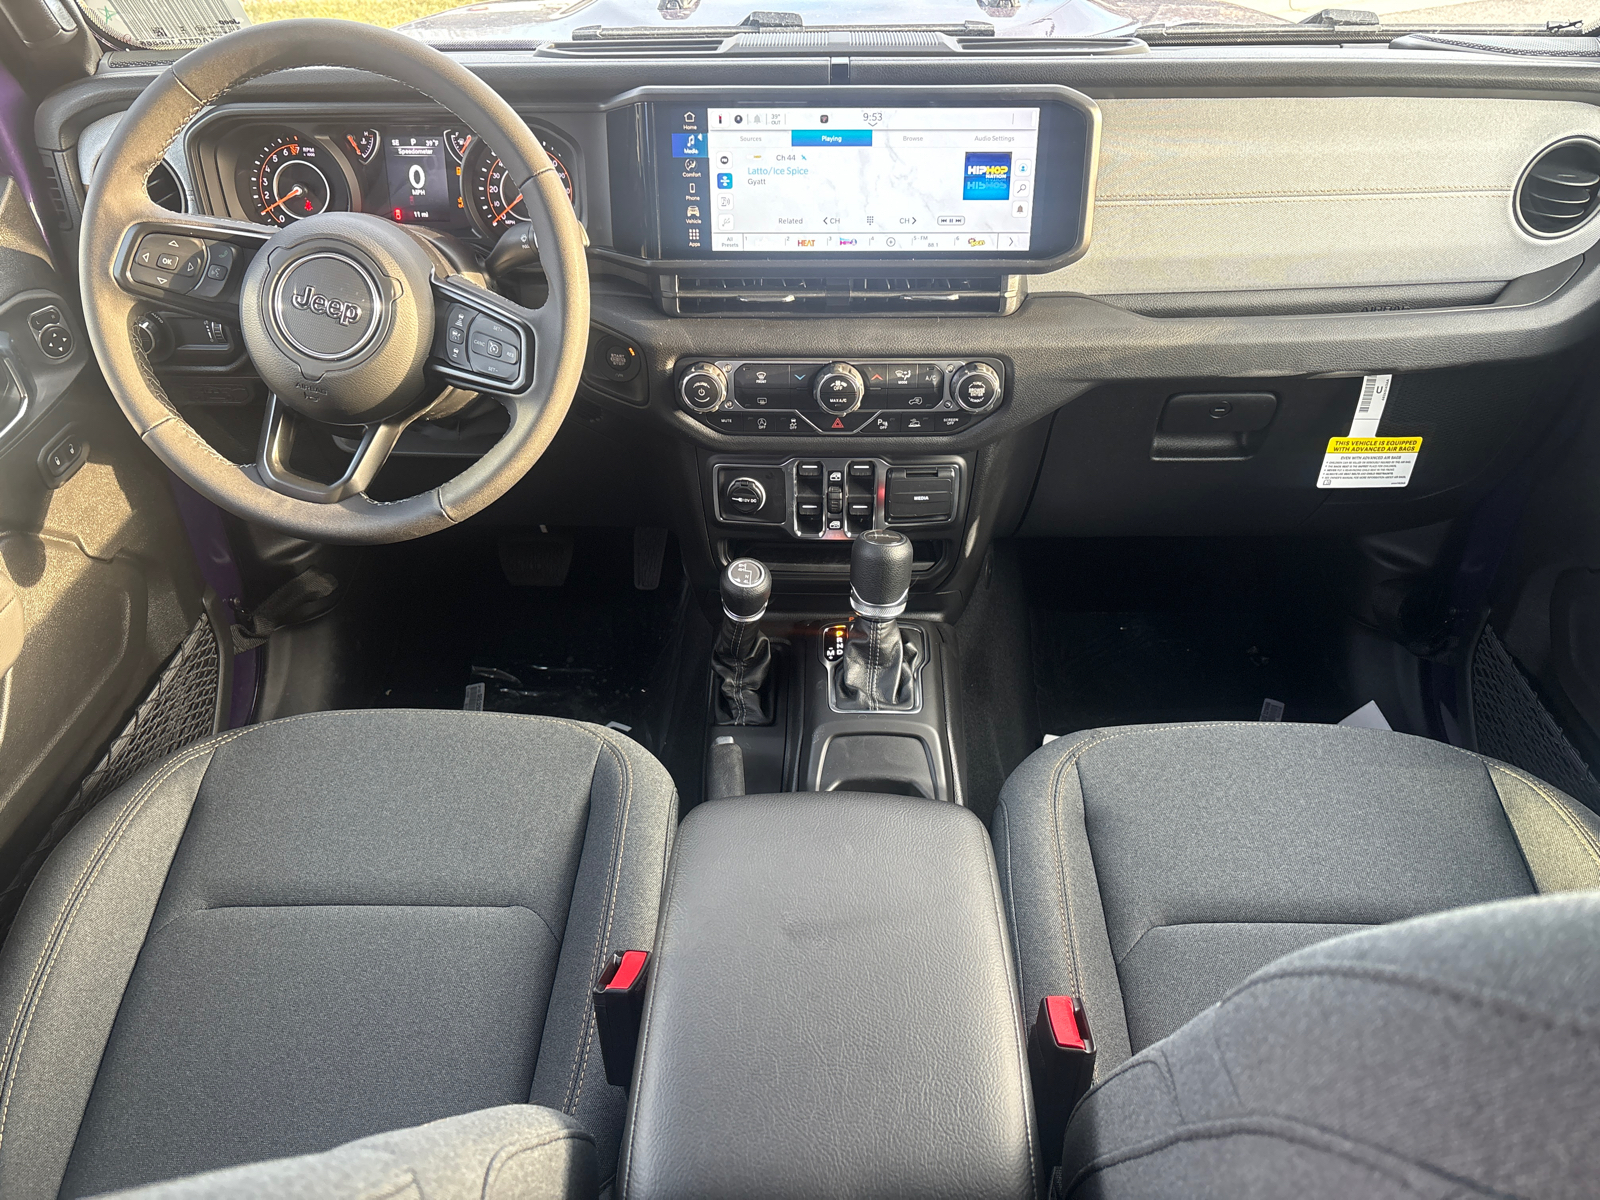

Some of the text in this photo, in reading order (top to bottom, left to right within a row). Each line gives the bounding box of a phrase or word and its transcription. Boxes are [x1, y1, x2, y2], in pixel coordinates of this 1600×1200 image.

[862, 112, 883, 122] 9:53
[410, 138, 417, 146] P
[821, 135, 843, 143] Playing
[992, 135, 1015, 143] Settings
[283, 148, 289, 156] 6
[272, 154, 278, 163] 5
[265, 165, 271, 173] 4
[786, 166, 809, 176] Spice
[408, 164, 426, 189] 0
[262, 178, 268, 186] 3
[747, 178, 766, 186] Gyatt
[264, 191, 270, 199] 2
[279, 214, 285, 223] 0
[797, 239, 815, 247] HEAT
[162, 257, 173, 266] OK
[292, 285, 362, 327] Jeep
[1376, 385, 1384, 394] U
